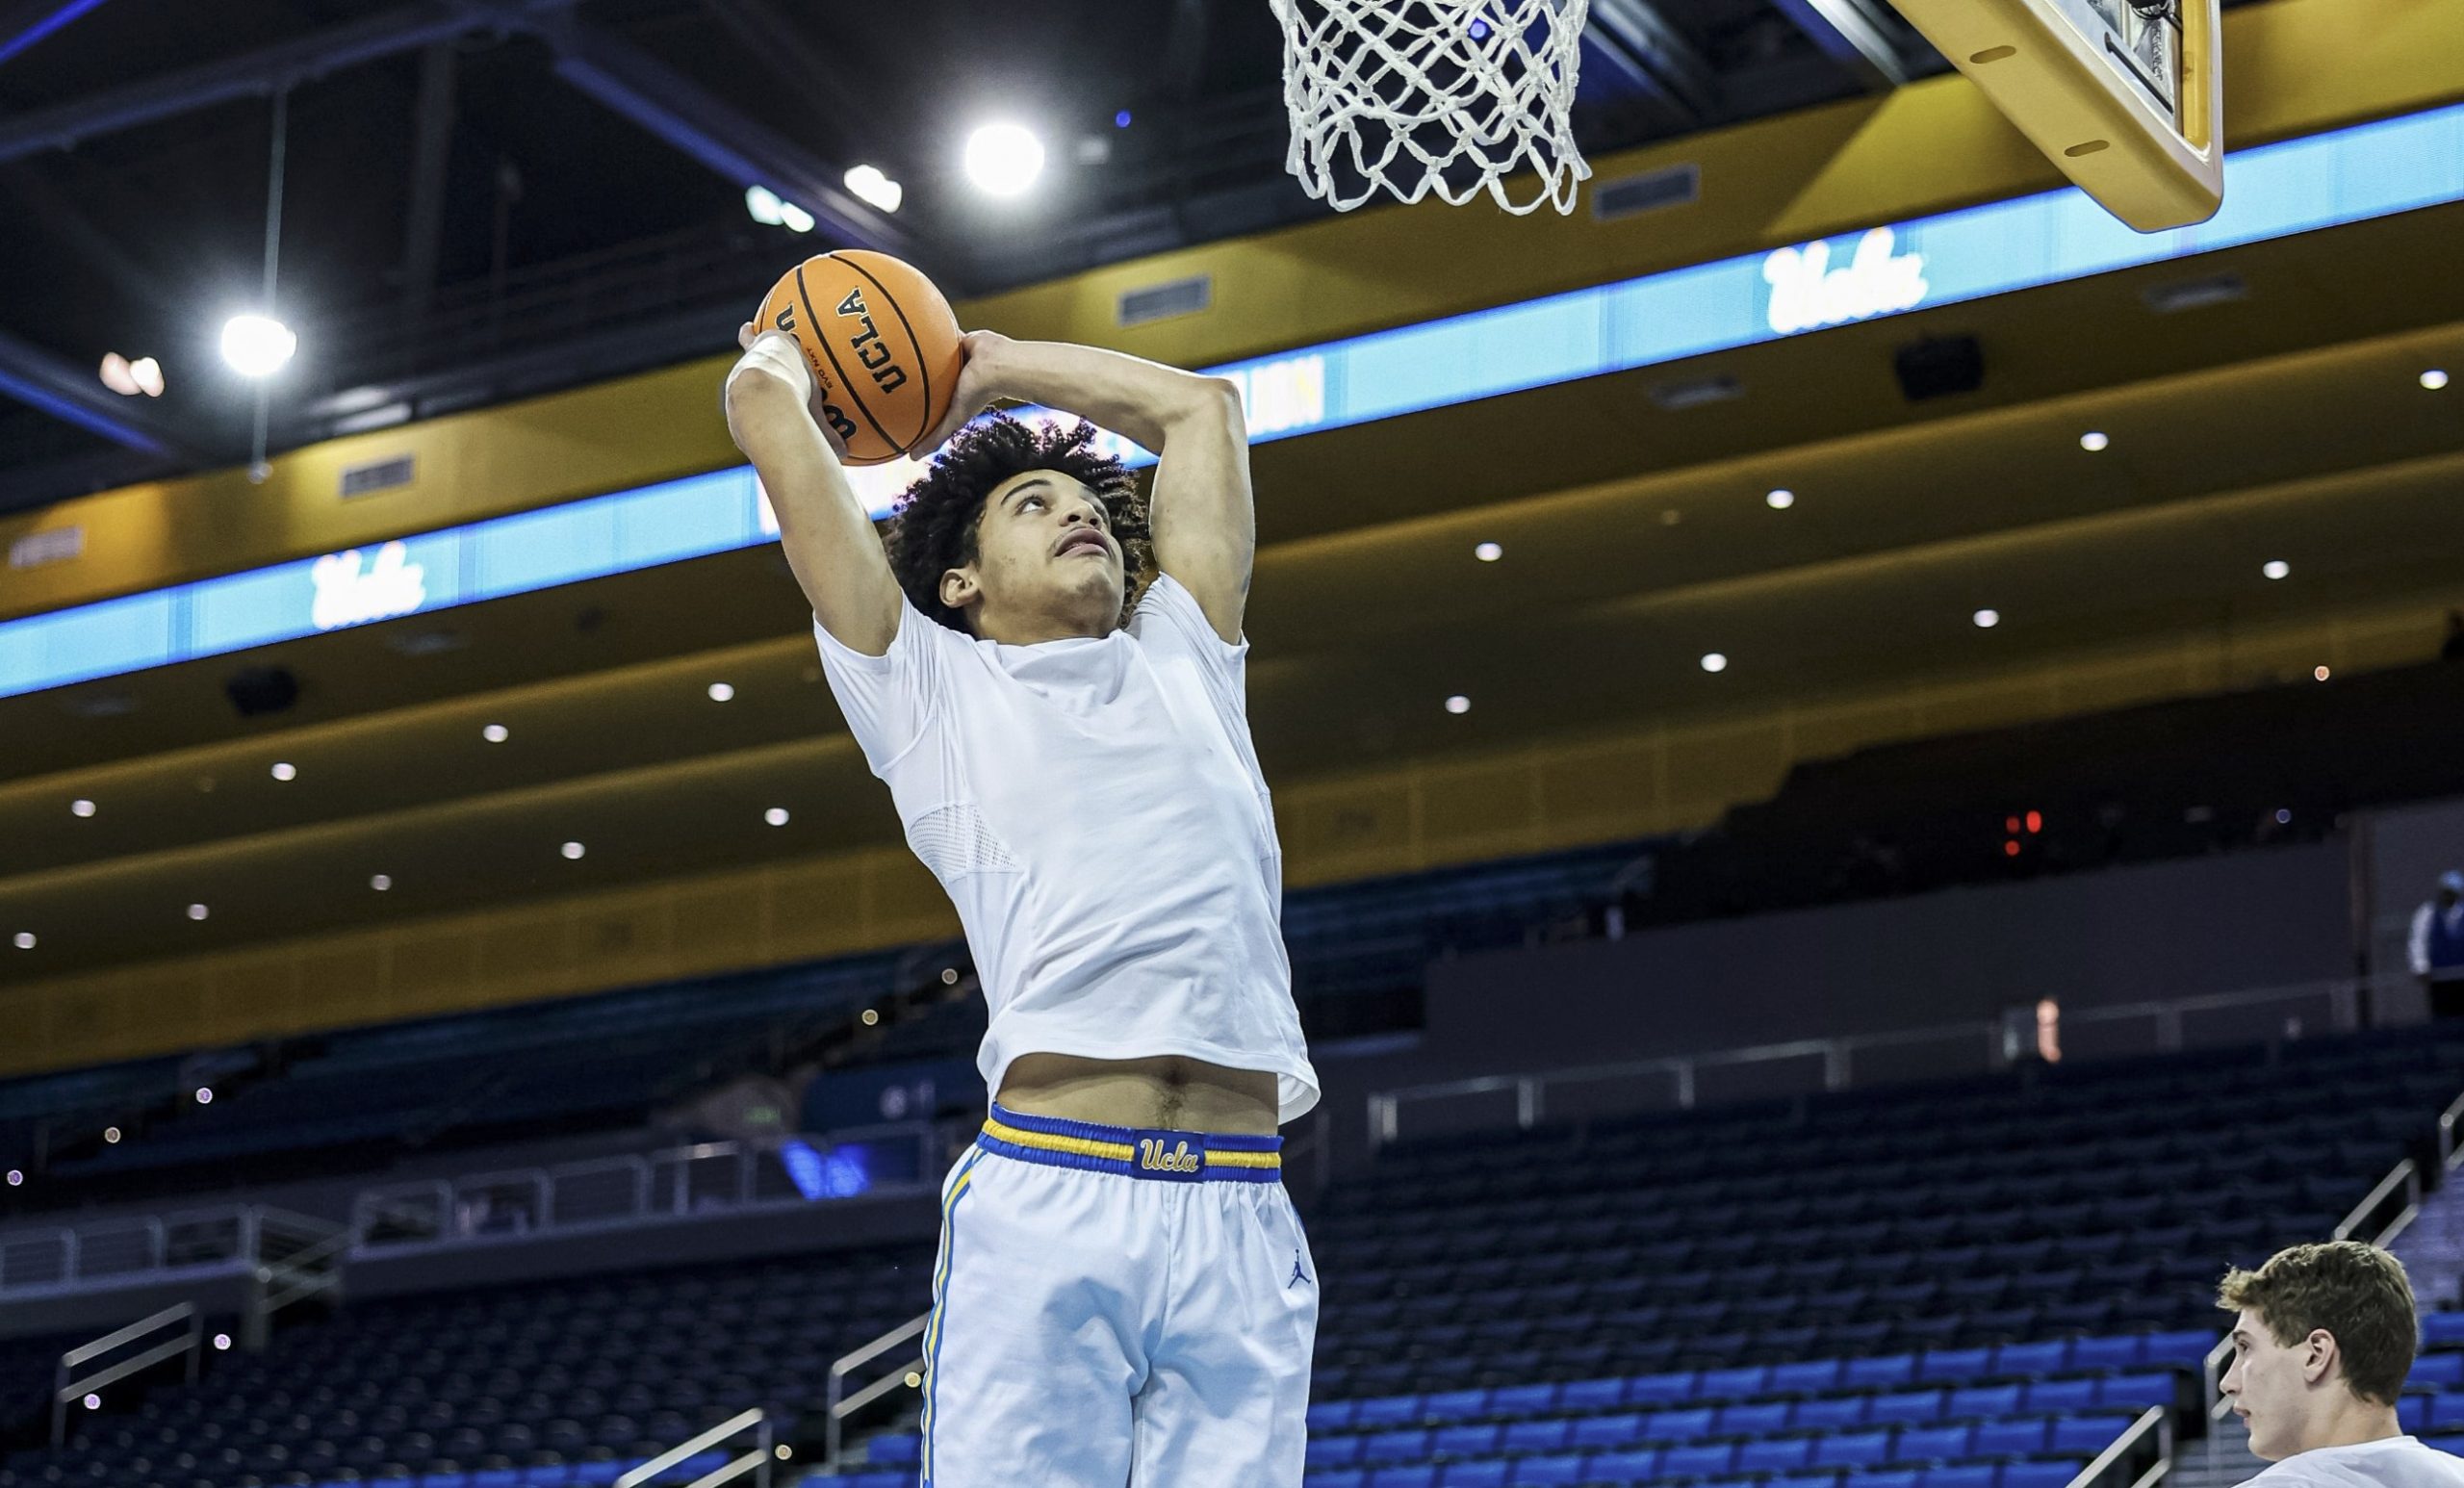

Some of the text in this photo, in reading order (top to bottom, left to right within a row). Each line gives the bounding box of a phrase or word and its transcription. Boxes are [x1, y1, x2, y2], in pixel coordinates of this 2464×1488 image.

[834, 286, 908, 395] UCLA
[807, 346, 834, 390] EVO NXT
[1140, 1138, 1199, 1173] Ucla
